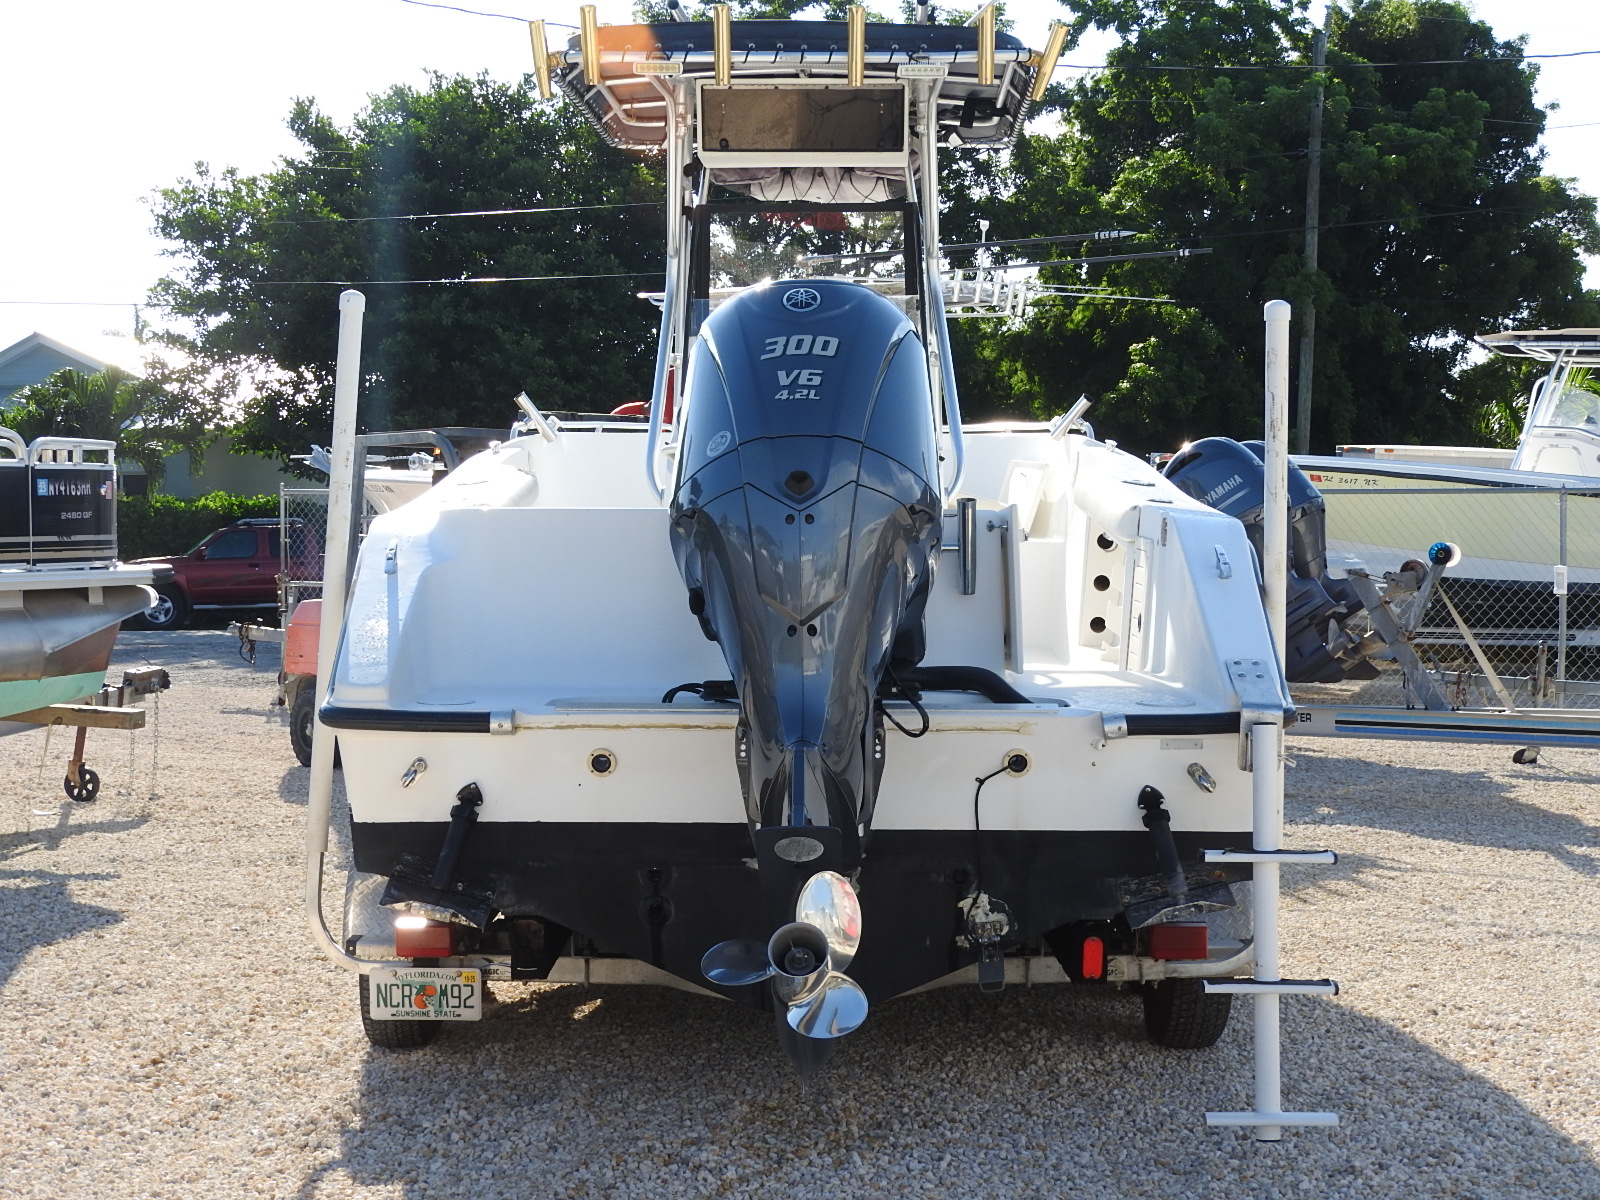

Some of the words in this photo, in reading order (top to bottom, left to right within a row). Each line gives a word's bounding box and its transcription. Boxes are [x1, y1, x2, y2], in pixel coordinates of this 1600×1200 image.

[760, 334, 839, 361] 300
[777, 369, 823, 386] V6
[774, 389, 821, 400] 4.2L
[1205, 474, 1243, 504] YAMAHA
[61, 511, 82, 519] 2480
[394, 971, 457, 982] MYFLORIDA.COM
[376, 983, 413, 1008] NCR
[439, 984, 475, 1008] M92
[395, 1010, 431, 1018] SUNSHINE
[433, 1010, 457, 1018] STATE
